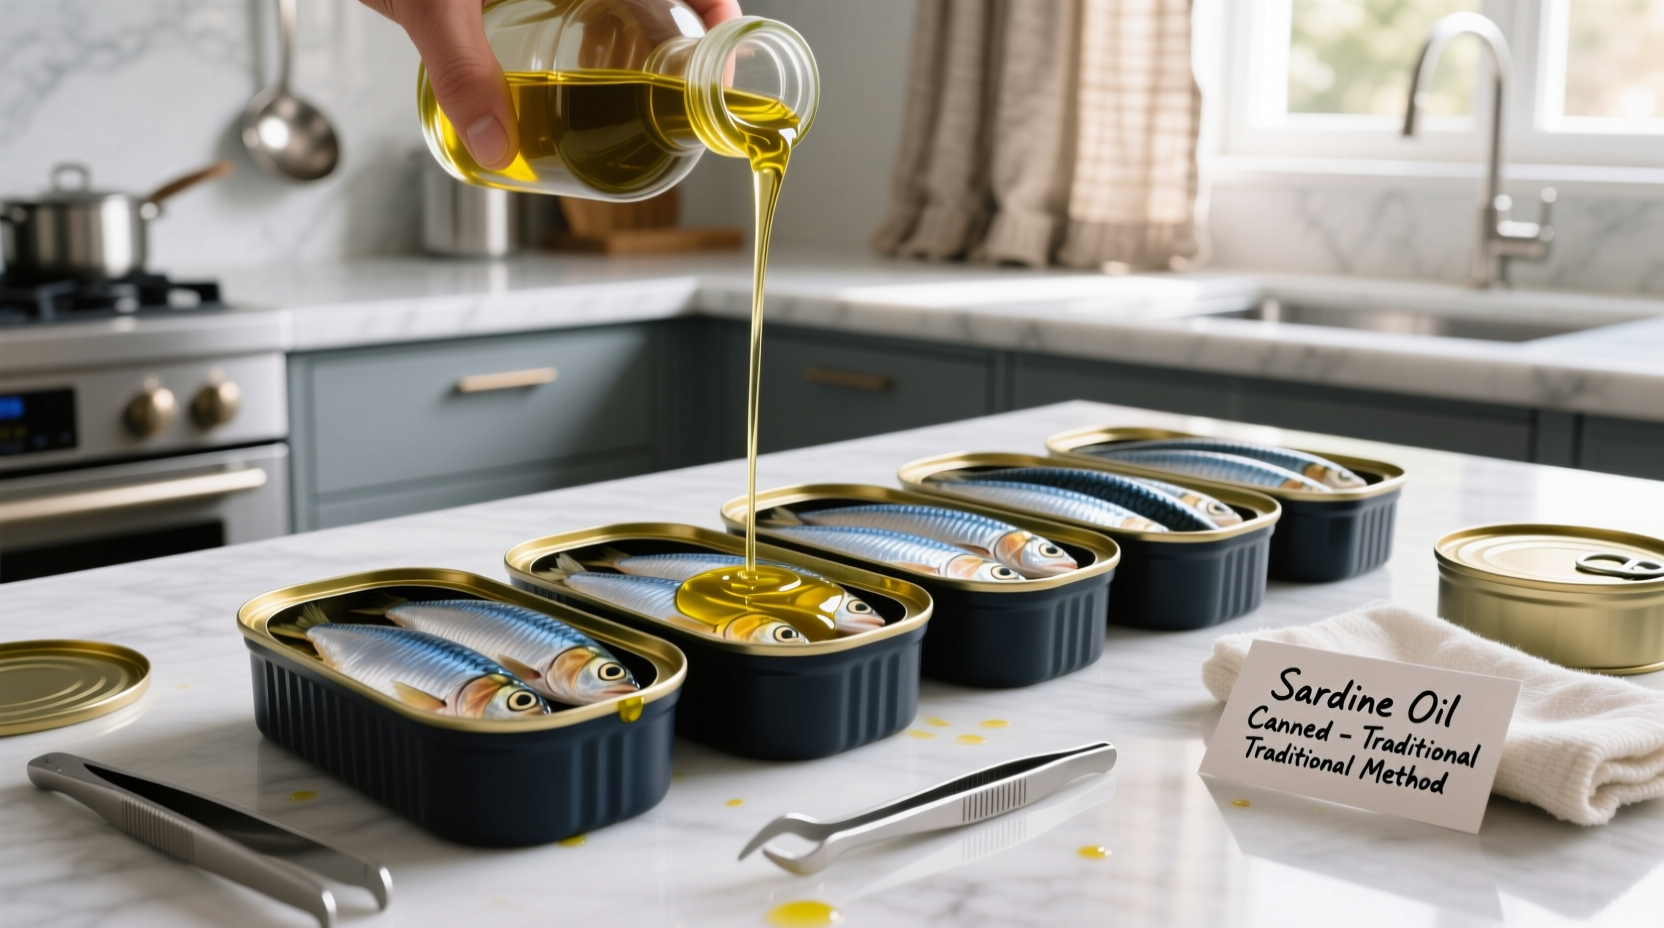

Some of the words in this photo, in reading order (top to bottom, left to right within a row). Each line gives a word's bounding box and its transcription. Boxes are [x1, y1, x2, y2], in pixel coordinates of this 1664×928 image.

[1270, 667, 1394, 718] Sardine
[1407, 689, 1462, 728] Oil
[1245, 736, 1356, 776] Traditional
[1358, 757, 1450, 795] Method
[1247, 705, 1334, 742] Canned
[1362, 725, 1482, 769] Traditional
